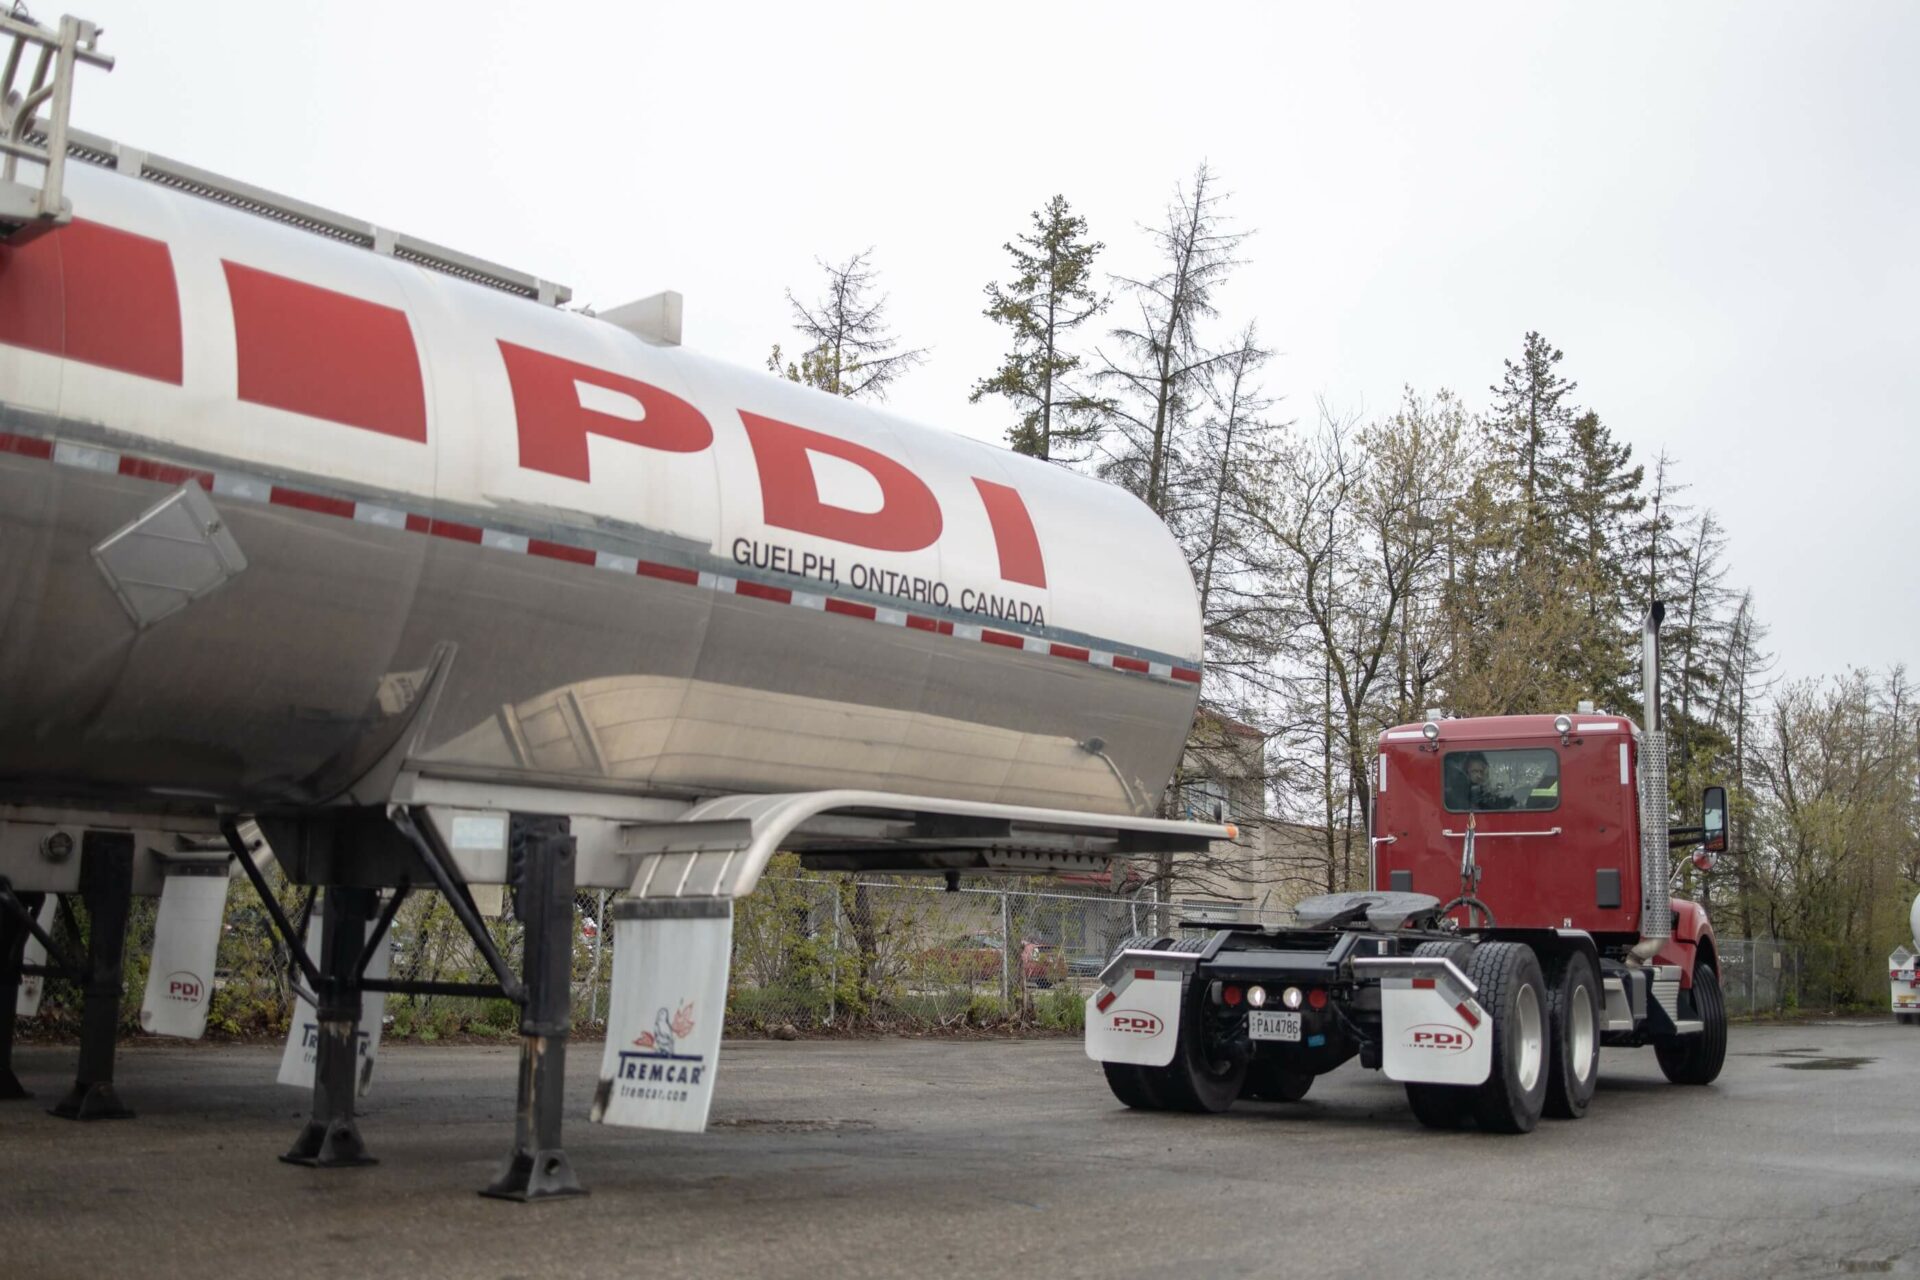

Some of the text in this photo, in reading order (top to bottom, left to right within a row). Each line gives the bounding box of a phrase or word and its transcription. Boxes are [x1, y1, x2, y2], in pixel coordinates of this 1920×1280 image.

[496, 338, 1047, 589] PDI
[732, 537, 1045, 627] GUELPH, ONTARIO, CANADA
[169, 981, 199, 997] PDI
[1114, 1017, 1155, 1029] PDI
[1257, 1019, 1298, 1034] PA14786
[1414, 1032, 1462, 1044] PDI
[620, 1085, 687, 1101] tremcar.com
